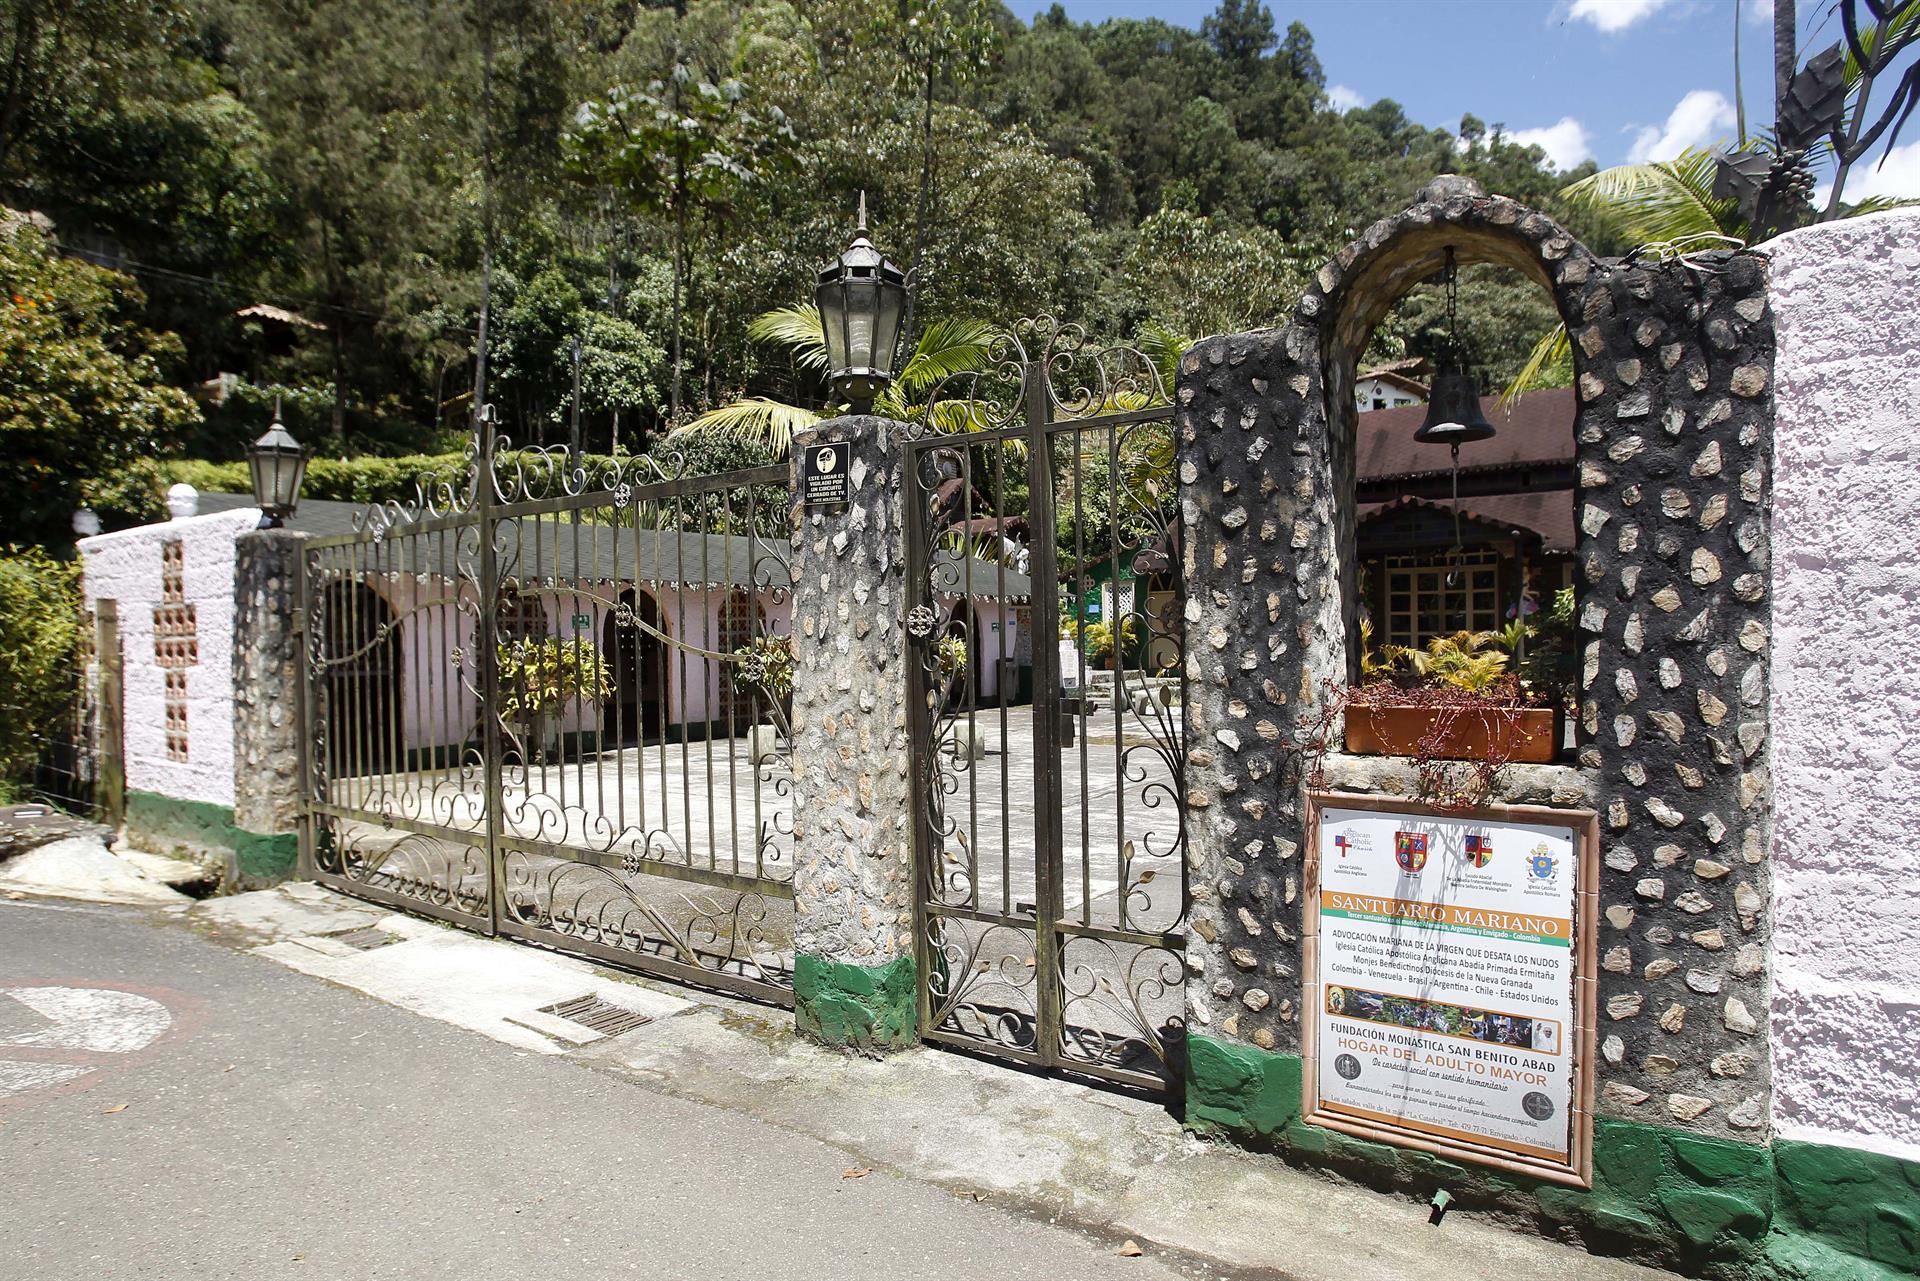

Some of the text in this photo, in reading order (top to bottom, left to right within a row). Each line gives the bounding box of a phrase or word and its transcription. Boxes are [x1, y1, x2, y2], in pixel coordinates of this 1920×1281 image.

[1332, 894, 1558, 935] SANTUARIO MARIANO
[1347, 911, 1362, 919] Tercer
[1363, 914, 1387, 922] santuario
[1450, 924, 1477, 934] Argentina
[1478, 928, 1482, 936] y
[1483, 928, 1508, 938] Envigado
[1513, 932, 1540, 942] Colombia
[1332, 929, 1559, 968] ADVOCACIÓN MARIANA DE LA VIRGEN QUE DESATA LOS NUDOS
[1335, 941, 1356, 951] Iglesia
[1357, 944, 1384, 956] Católica
[1385, 949, 1421, 961] Apostólica
[1423, 954, 1457, 966] Anglicana
[1487, 963, 1518, 975] Primada
[1520, 968, 1555, 980] Ermitaña
[1331, 963, 1363, 975] Colombia
[1368, 968, 1403, 982] Venezuela
[1408, 975, 1428, 986] Brasil
[1433, 979, 1469, 992] Argentina
[1475, 985, 1494, 996] Chile
[1500, 989, 1530, 1002] Estados
[1531, 993, 1559, 1006] Unidos
[1353, 955, 1533, 990] Monjes Benedictinos Diócesis de la Nueva Granada
[1330, 1023, 1555, 1073] FUNDACIÓN MONÁSTICA SAN BENITO ABAD
[1338, 1037, 1547, 1087] HOGAR DEL ADULTO MAYOR
[1372, 1057, 1508, 1092] De carácter social con sentido humanitario
[1362, 1102, 1376, 1110] valle
[1489, 1128, 1518, 1142] Envigado
[1524, 1136, 1556, 1149] Colombia
